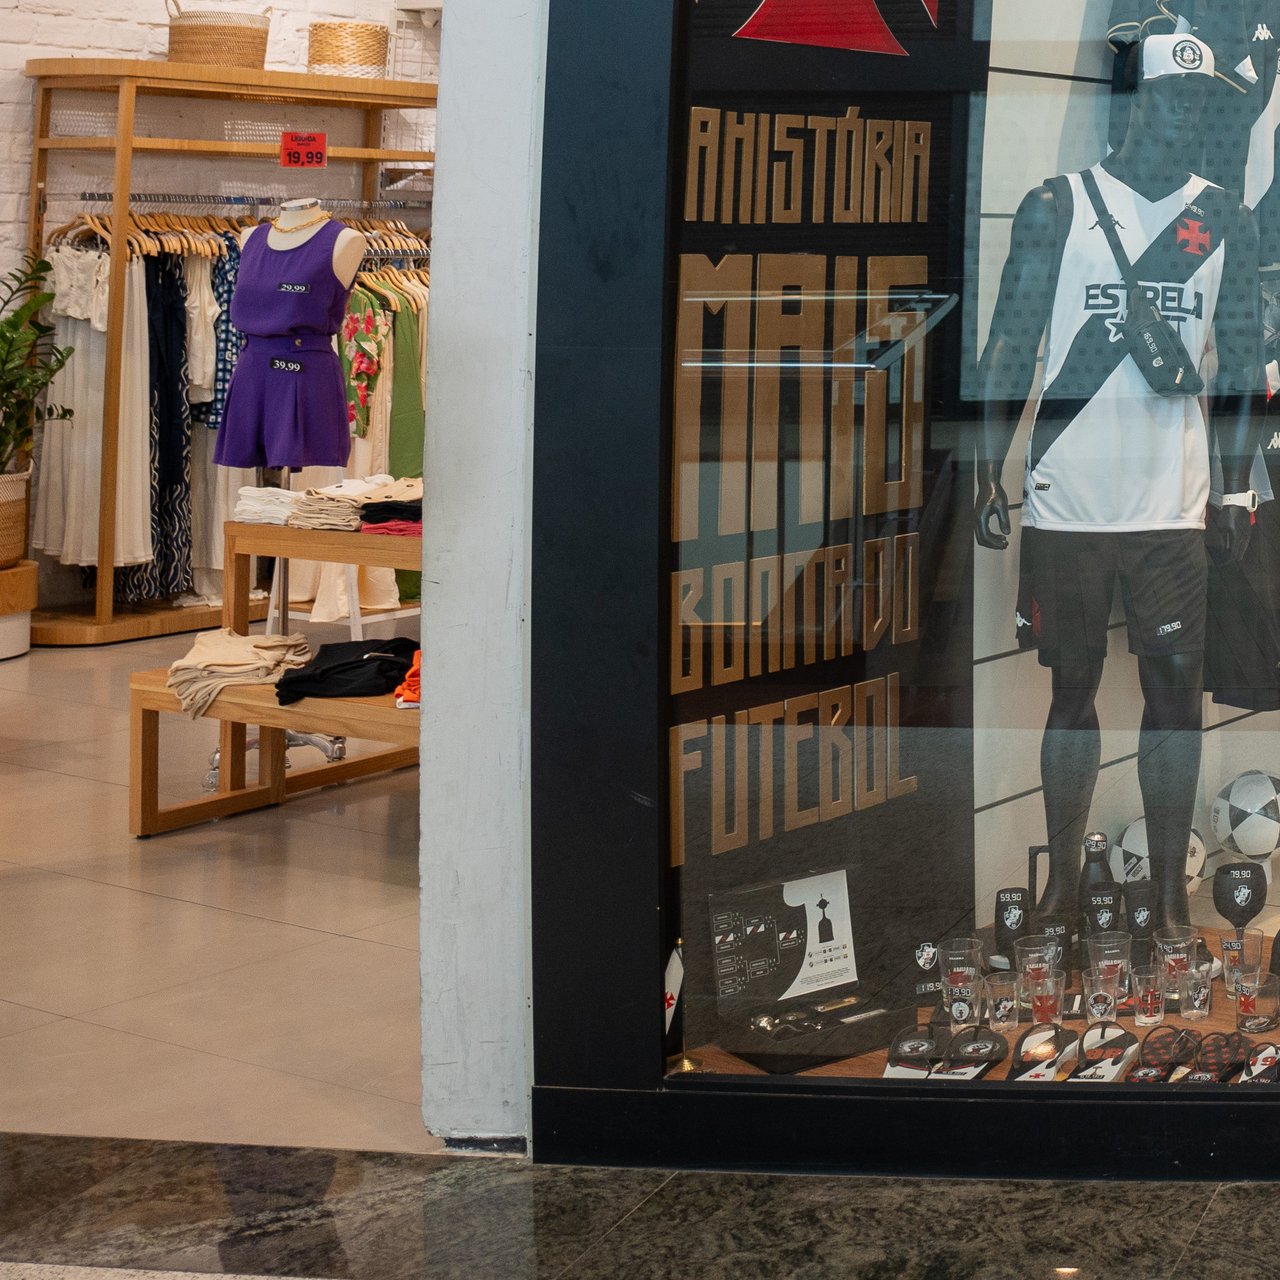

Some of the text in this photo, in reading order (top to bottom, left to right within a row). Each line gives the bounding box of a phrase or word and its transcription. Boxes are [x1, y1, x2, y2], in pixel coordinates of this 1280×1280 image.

[286, 151, 323, 166] 19,99
[685, 106, 932, 224] A HISTÓRIA
[671, 253, 929, 543] MAIS
[671, 532, 920, 695] BONITA DO
[669, 671, 918, 868] FUTEBOL
